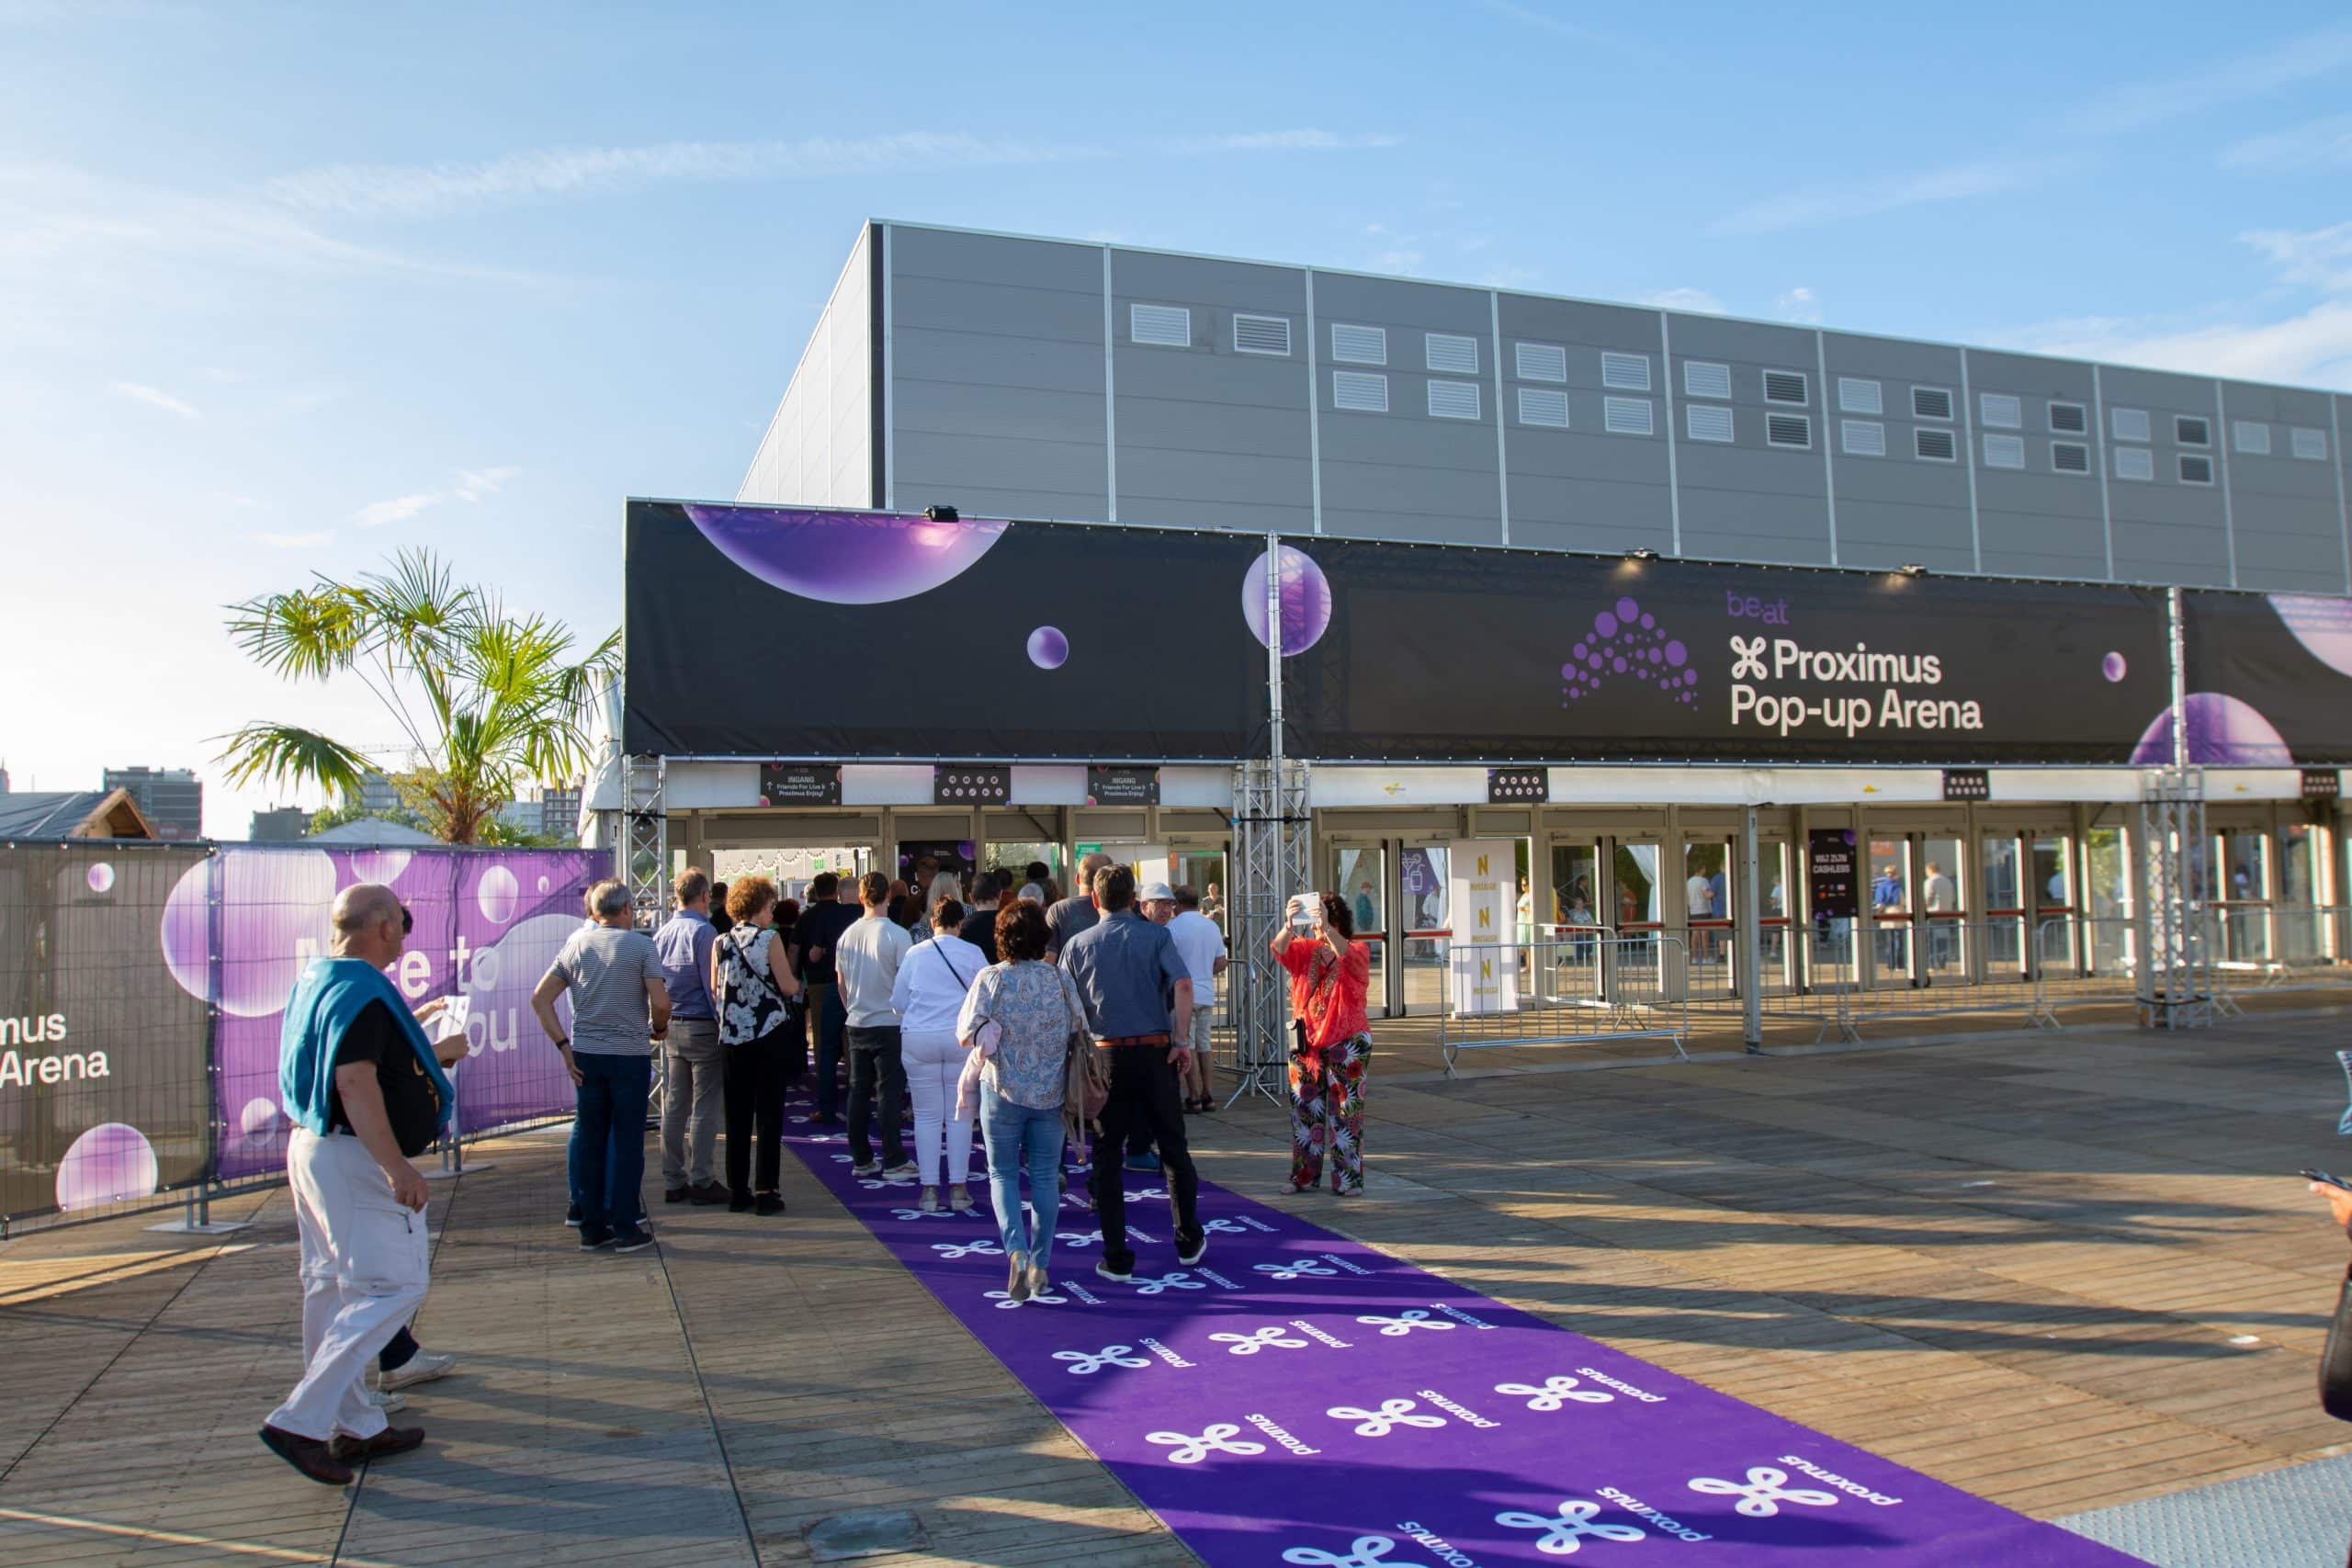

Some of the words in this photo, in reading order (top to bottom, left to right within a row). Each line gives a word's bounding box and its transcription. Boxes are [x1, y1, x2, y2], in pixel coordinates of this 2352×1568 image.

[1774, 639, 1942, 684] Proximus
[1731, 684, 1871, 738] Pop-up
[1879, 689, 1984, 728] Arena
[1477, 853, 1488, 876] N
[1813, 864, 1851, 874] CASHLESS
[1478, 906, 1490, 929] N
[449, 935, 500, 994] to
[465, 1007, 517, 1057] ou
[0, 1051, 110, 1088] Arena
[1319, 1254, 1377, 1275] proximus
[1289, 1320, 1353, 1348] proximus
[1430, 1303, 1500, 1329] proximus
[1139, 1337, 1197, 1368] proximus
[1575, 1367, 1668, 1403] proximus
[1416, 1390, 1501, 1428] proximus
[1244, 1413, 1322, 1455] proximus
[1777, 1455, 1904, 1506] proximus
[1595, 1486, 1713, 1542] proximus
[1396, 1521, 1482, 1568] oximus
